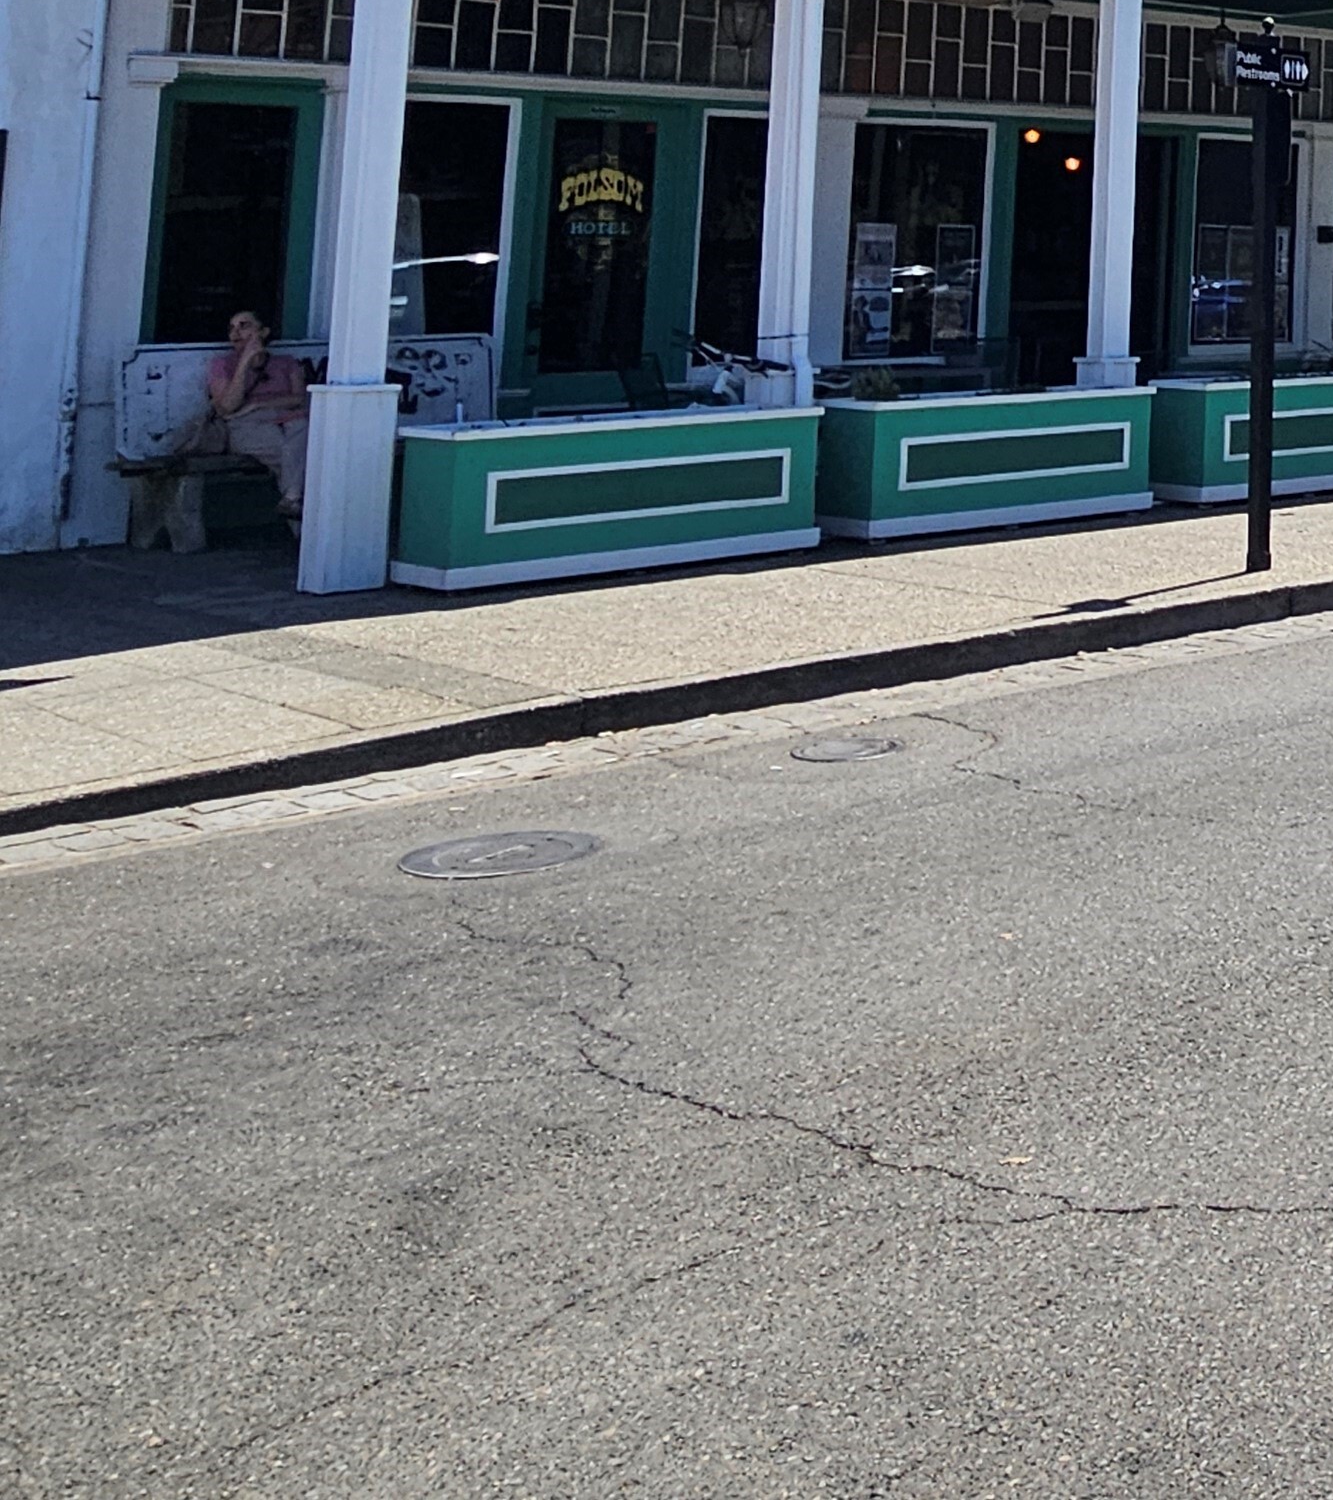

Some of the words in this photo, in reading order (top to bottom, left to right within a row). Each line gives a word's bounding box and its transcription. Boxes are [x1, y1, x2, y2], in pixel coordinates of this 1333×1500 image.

[1236, 50, 1262, 66] Public
[1236, 65, 1280, 82] Restrooms
[558, 167, 644, 213] FOLSOM
[570, 221, 632, 236] HOTEL
